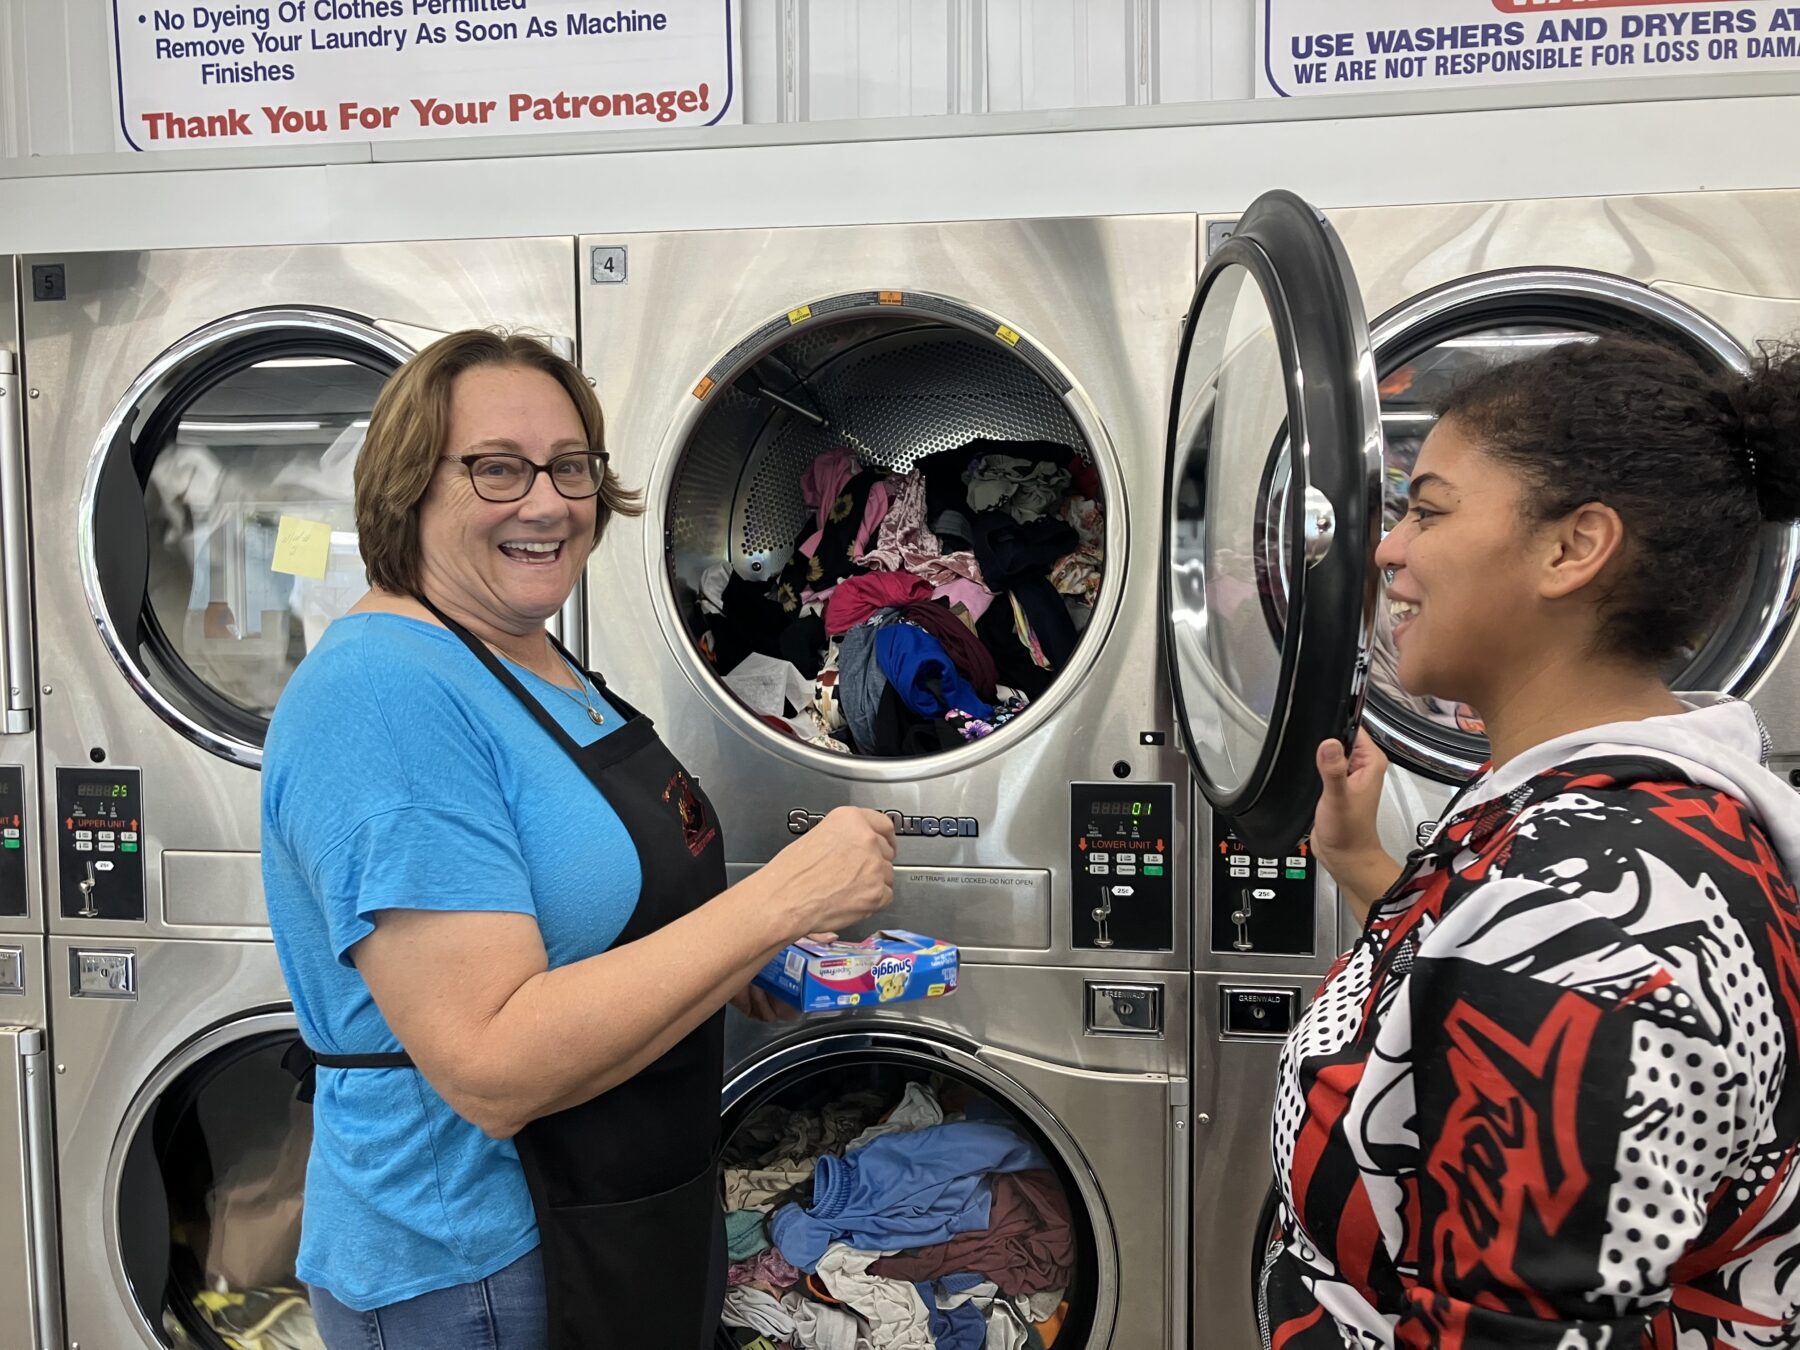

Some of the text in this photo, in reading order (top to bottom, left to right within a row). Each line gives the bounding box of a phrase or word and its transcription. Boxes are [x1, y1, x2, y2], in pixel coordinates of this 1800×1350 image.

[154, 10, 184, 31] No
[193, 5, 270, 33] Dyeing
[279, 1, 306, 23] Of
[314, 0, 404, 21] Clothes
[156, 10, 667, 60] Remove Your Laundry As Soon As Machine
[1292, 33, 1354, 60] USE
[1366, 21, 1525, 54] WASHERS
[1536, 17, 1608, 44] AND
[1622, 9, 1757, 39] DRYERS
[1294, 36, 1800, 84] WE ARE NOT RESPONSIBLE FOR LOSS OR DAM
[202, 60, 296, 85] Finishes
[143, 83, 710, 140] Thank You For Your Patronage!
[604, 257, 615, 273] 4
[44, 275, 54, 290] 5
[1131, 802, 1152, 815] 01
[78, 819, 125, 829] UPPER UNIT
[1091, 840, 1151, 849] LOWER UNIT
[872, 959, 912, 978] Snuggle
[1103, 990, 1146, 999] GREENWALD
[1239, 994, 1281, 1003] GREENWALD
